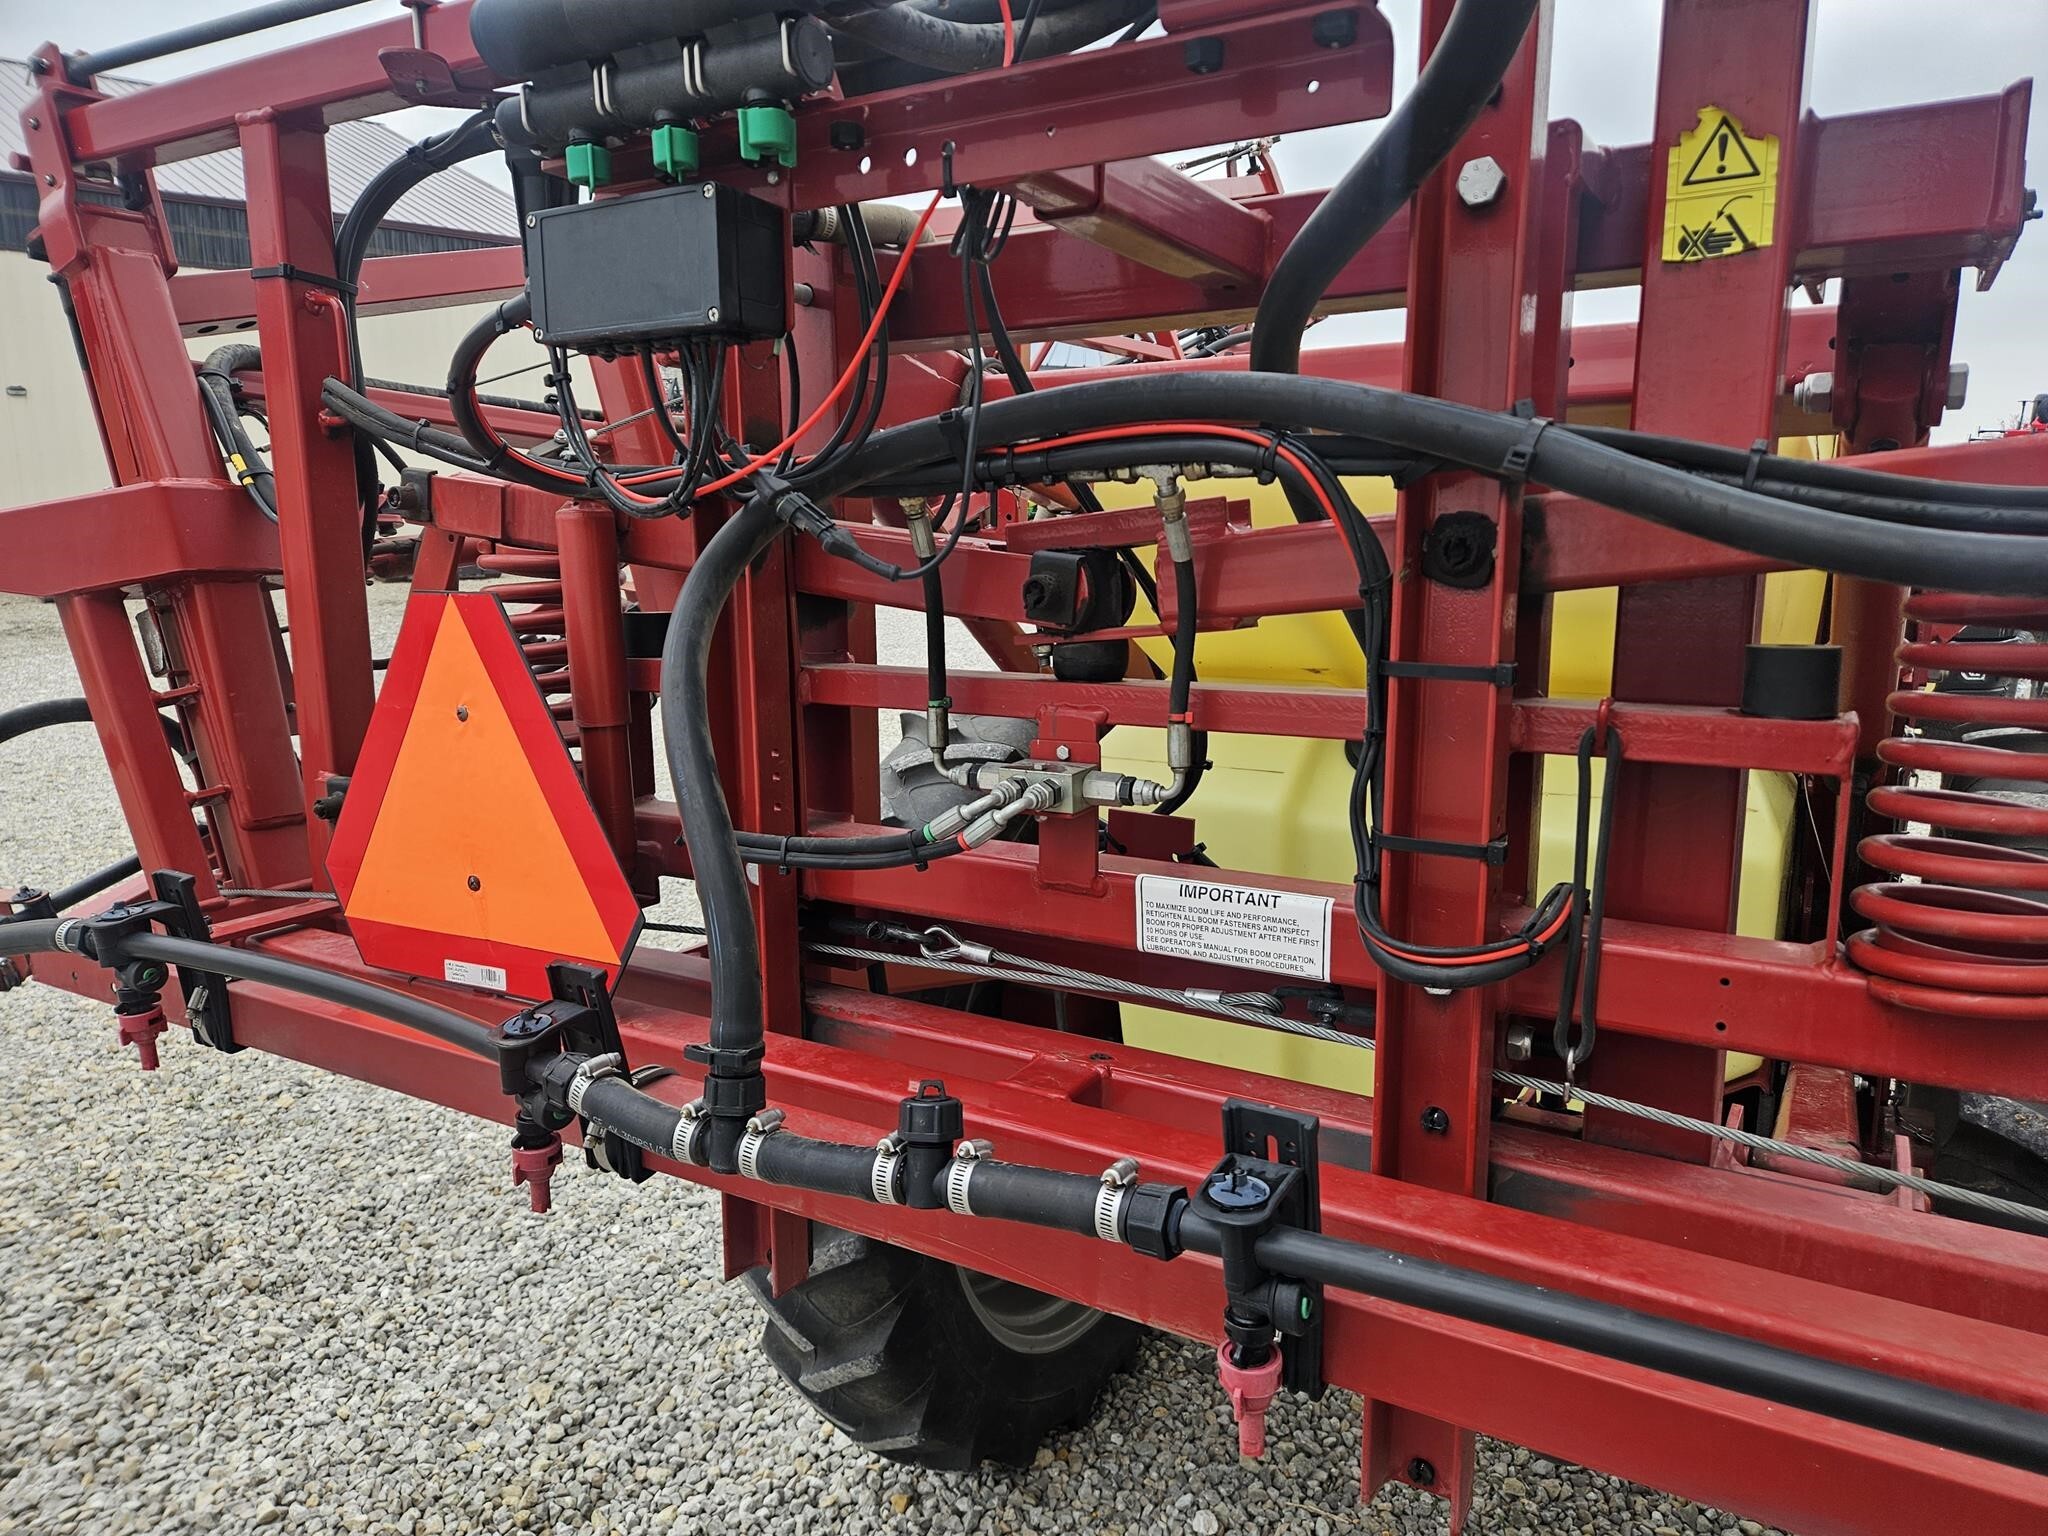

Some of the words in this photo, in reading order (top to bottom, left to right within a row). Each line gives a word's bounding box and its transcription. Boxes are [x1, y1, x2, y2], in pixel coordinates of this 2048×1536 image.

[1179, 883, 1281, 908] IMPORTANT
[1156, 902, 1186, 912] MAXIMIZE
[1188, 906, 1208, 915] BOOM
[1146, 910, 1182, 920] RETIGHTEN
[1198, 916, 1218, 926] BOOM
[1220, 920, 1261, 930] FASTENERS
[1280, 926, 1310, 936] INSPECT
[1146, 918, 1166, 926] BOOM
[1182, 923, 1209, 933] PROPER
[1211, 926, 1256, 939] ADJUSTMENT
[1258, 933, 1282, 942] AFTER
[1283, 936, 1298, 944] THE
[1299, 938, 1319, 947] FIRST
[1155, 928, 1178, 936] HOURS
[1190, 932, 1204, 940] USE.
[1160, 937, 1202, 948] OPERATOR'S
[1204, 943, 1232, 953] MANUAL
[1234, 947, 1248, 955] FOR
[1250, 949, 1272, 958] BOOM
[1208, 952, 1254, 965] ADJUSTMENT
[1256, 959, 1306, 972] PROCEDURES.
